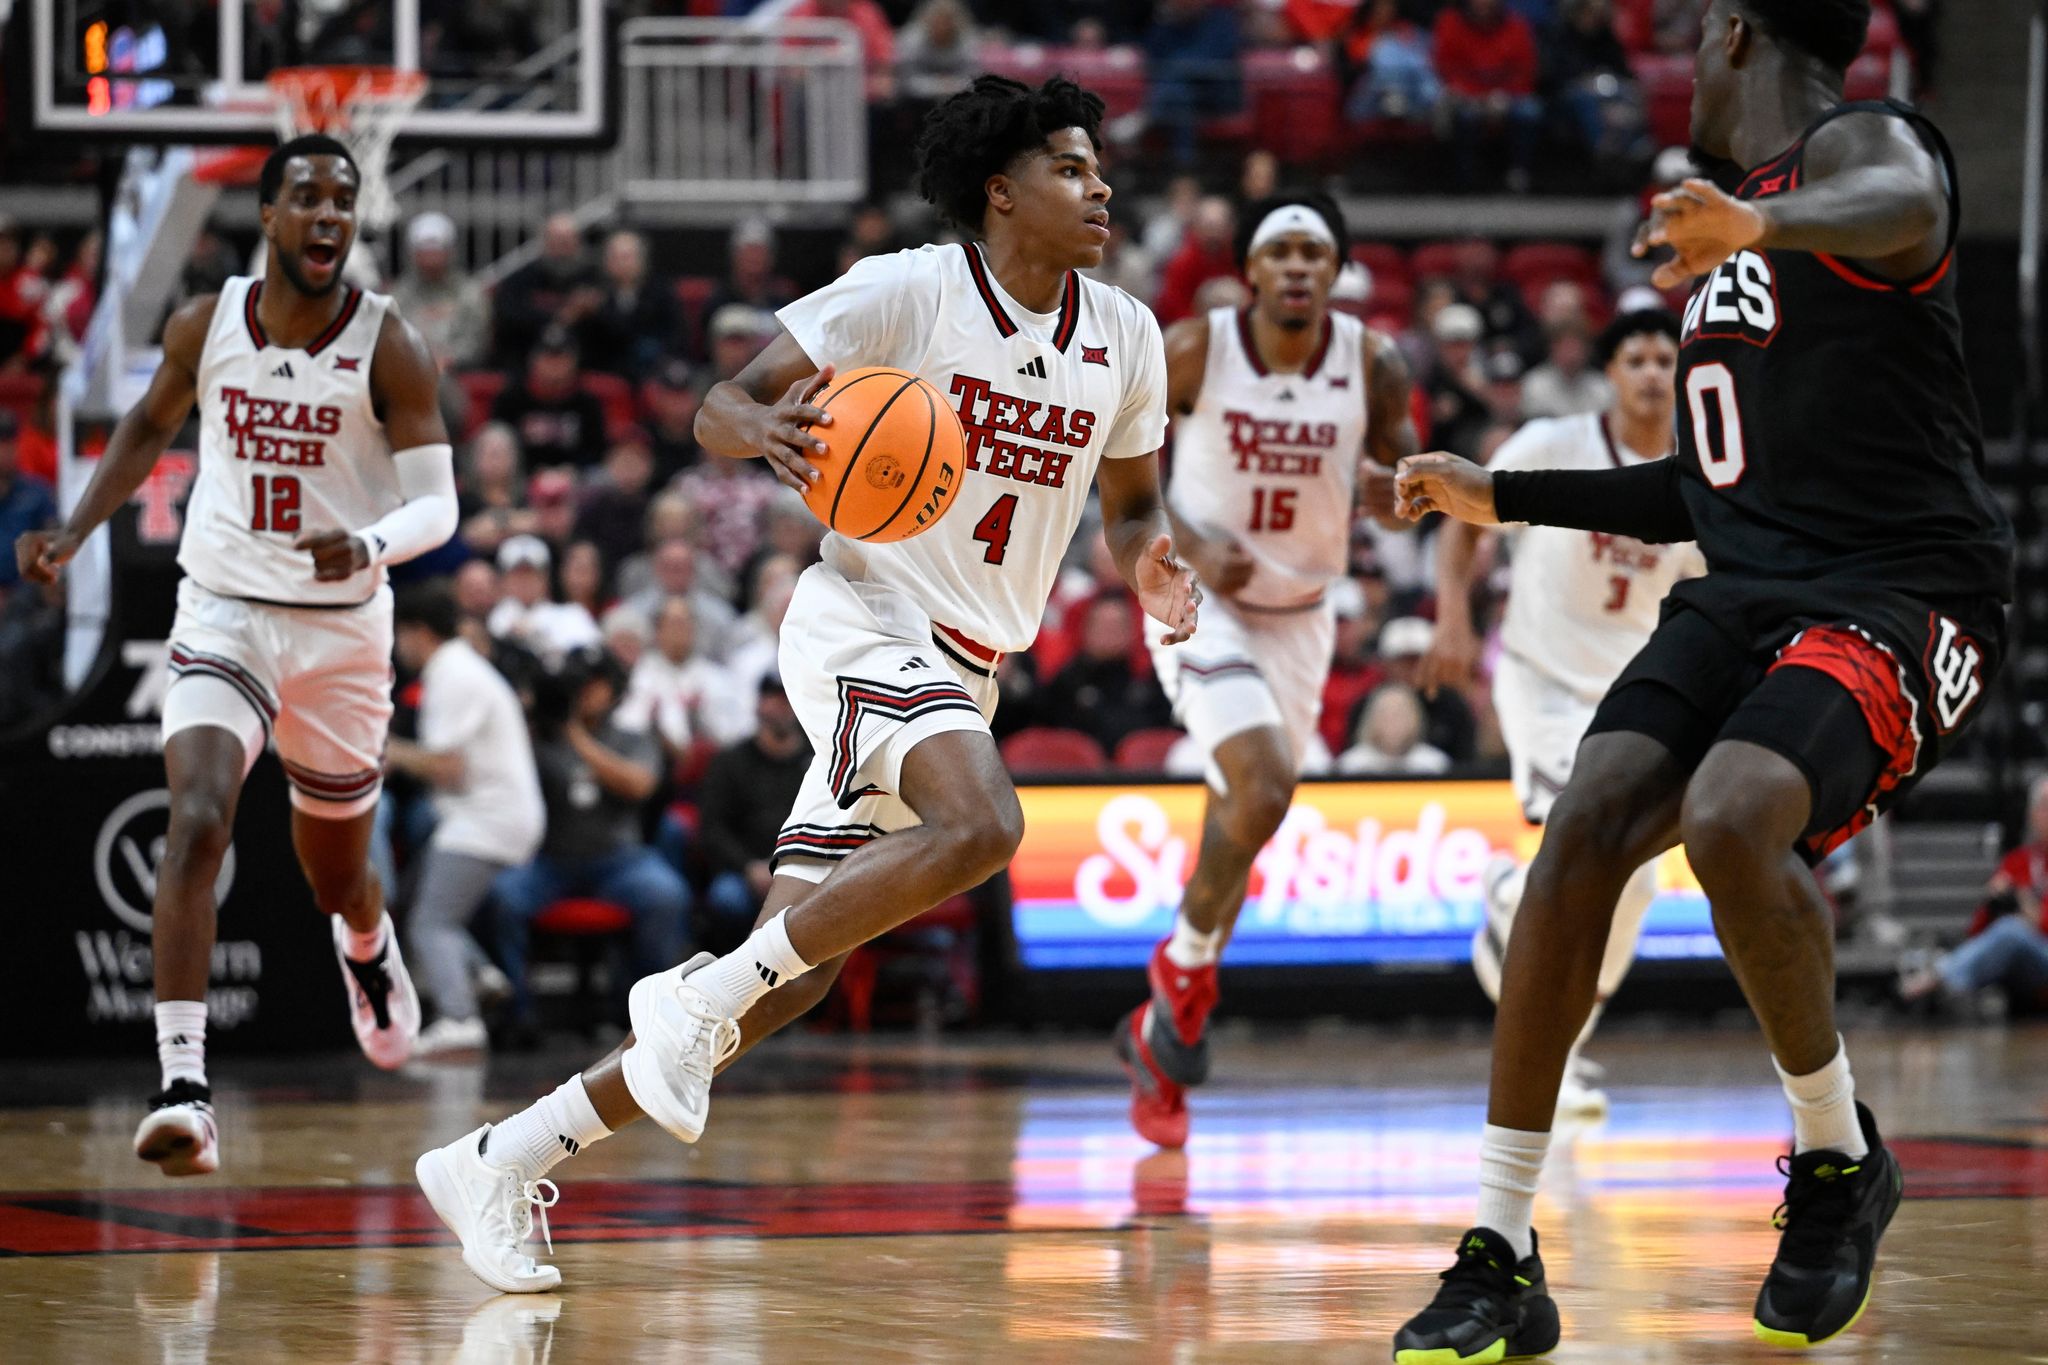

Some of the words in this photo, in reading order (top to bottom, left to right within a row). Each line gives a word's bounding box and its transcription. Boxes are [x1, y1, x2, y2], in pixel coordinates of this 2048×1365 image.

[221, 386, 342, 434] TEXAS
[950, 373, 1096, 448] TEXAS
[1223, 411, 1338, 449] TEXAS
[1687, 363, 1745, 487] 0
[229, 421, 326, 466] TECH
[964, 424, 1072, 488] TECH
[1232, 443, 1322, 476] TECH
[251, 474, 301, 532] 12
[915, 461, 954, 526] EVO
[1248, 487, 1299, 533] 15
[973, 493, 1019, 566] 4
